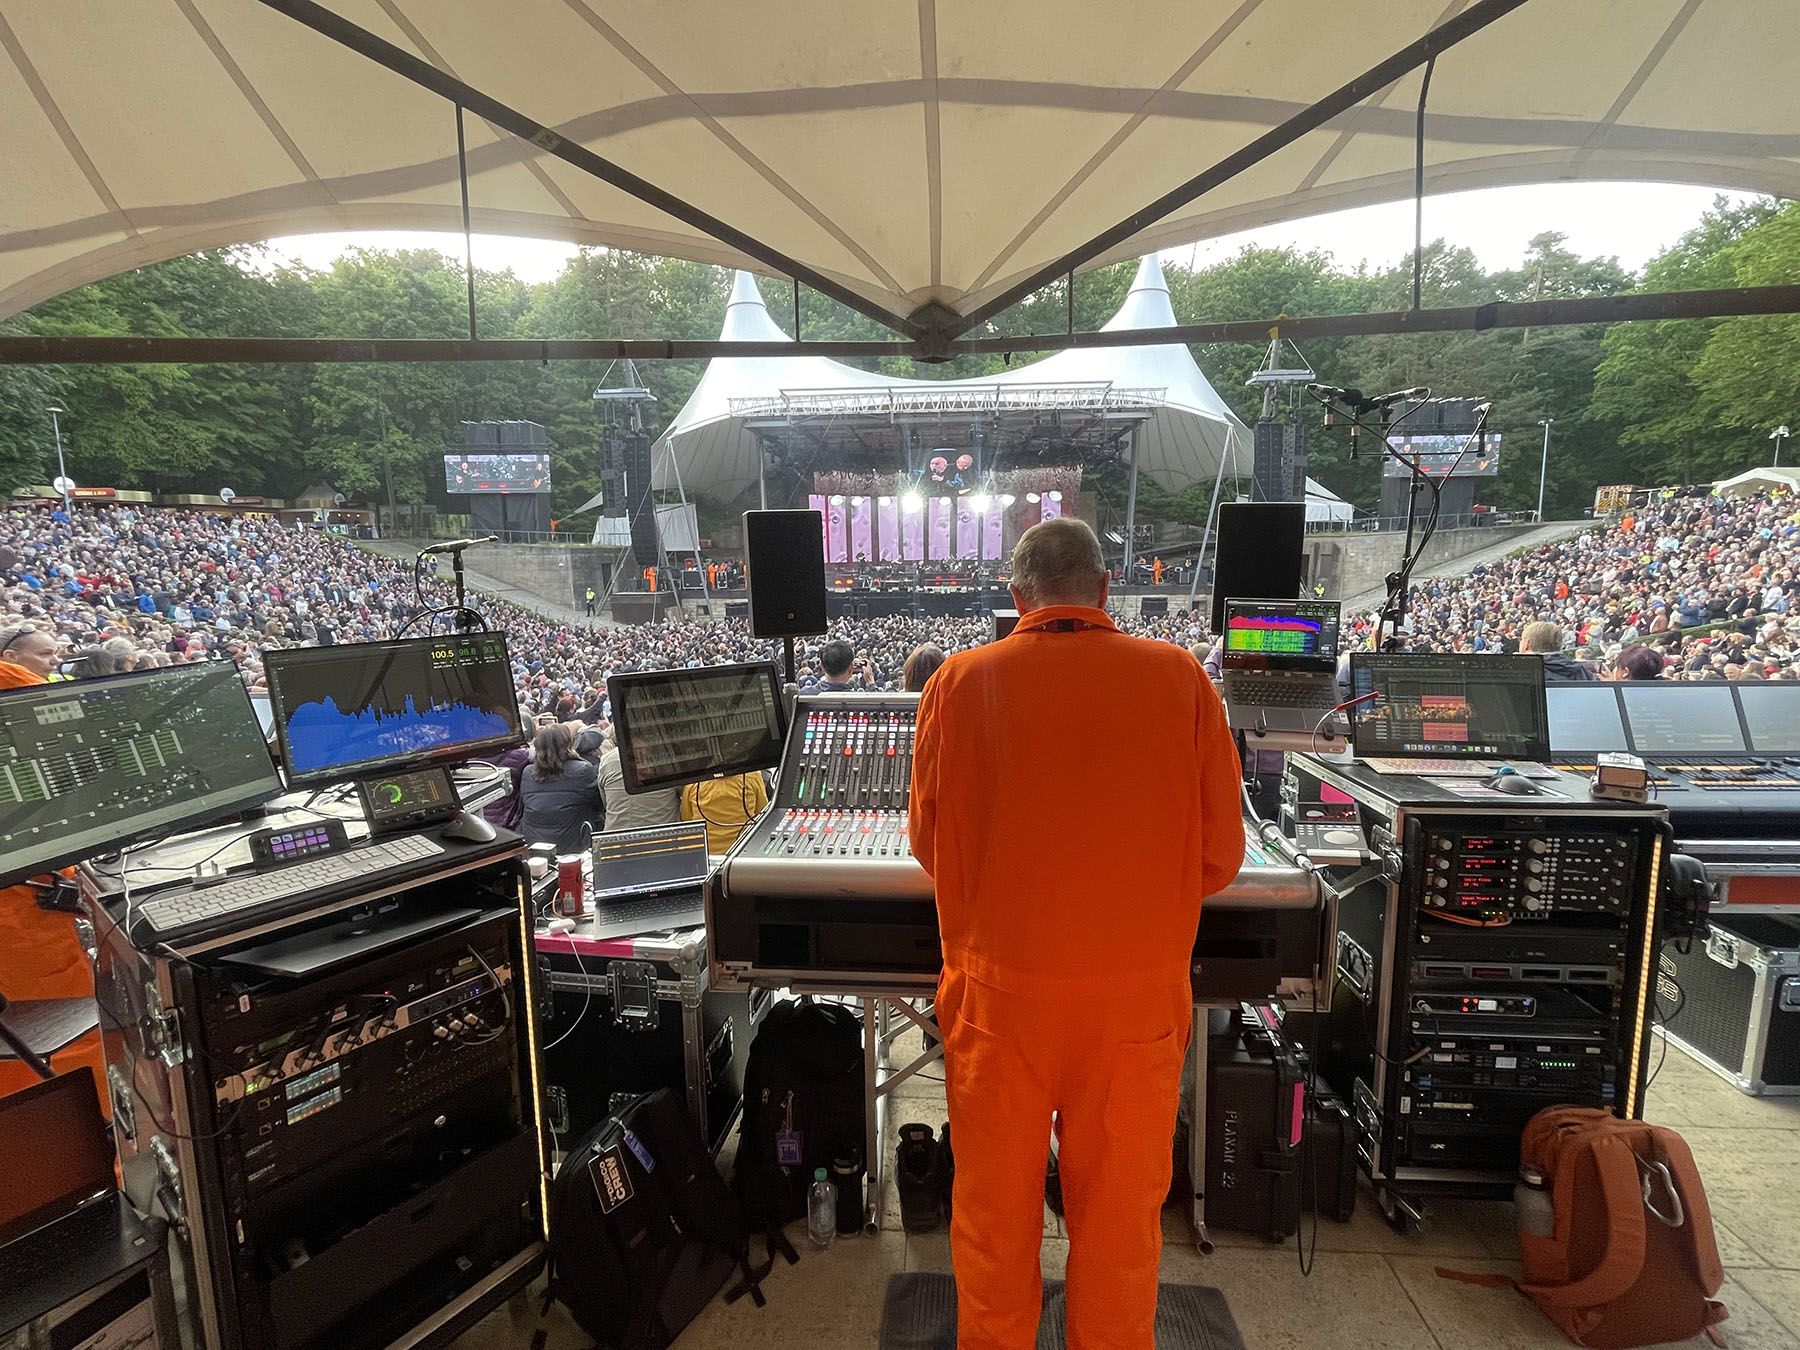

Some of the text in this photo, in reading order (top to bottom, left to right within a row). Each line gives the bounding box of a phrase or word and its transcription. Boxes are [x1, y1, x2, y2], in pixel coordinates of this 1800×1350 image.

[431, 649, 454, 659] 100.5
[458, 647, 477, 656] 98.8
[605, 1156, 626, 1200] CREW
